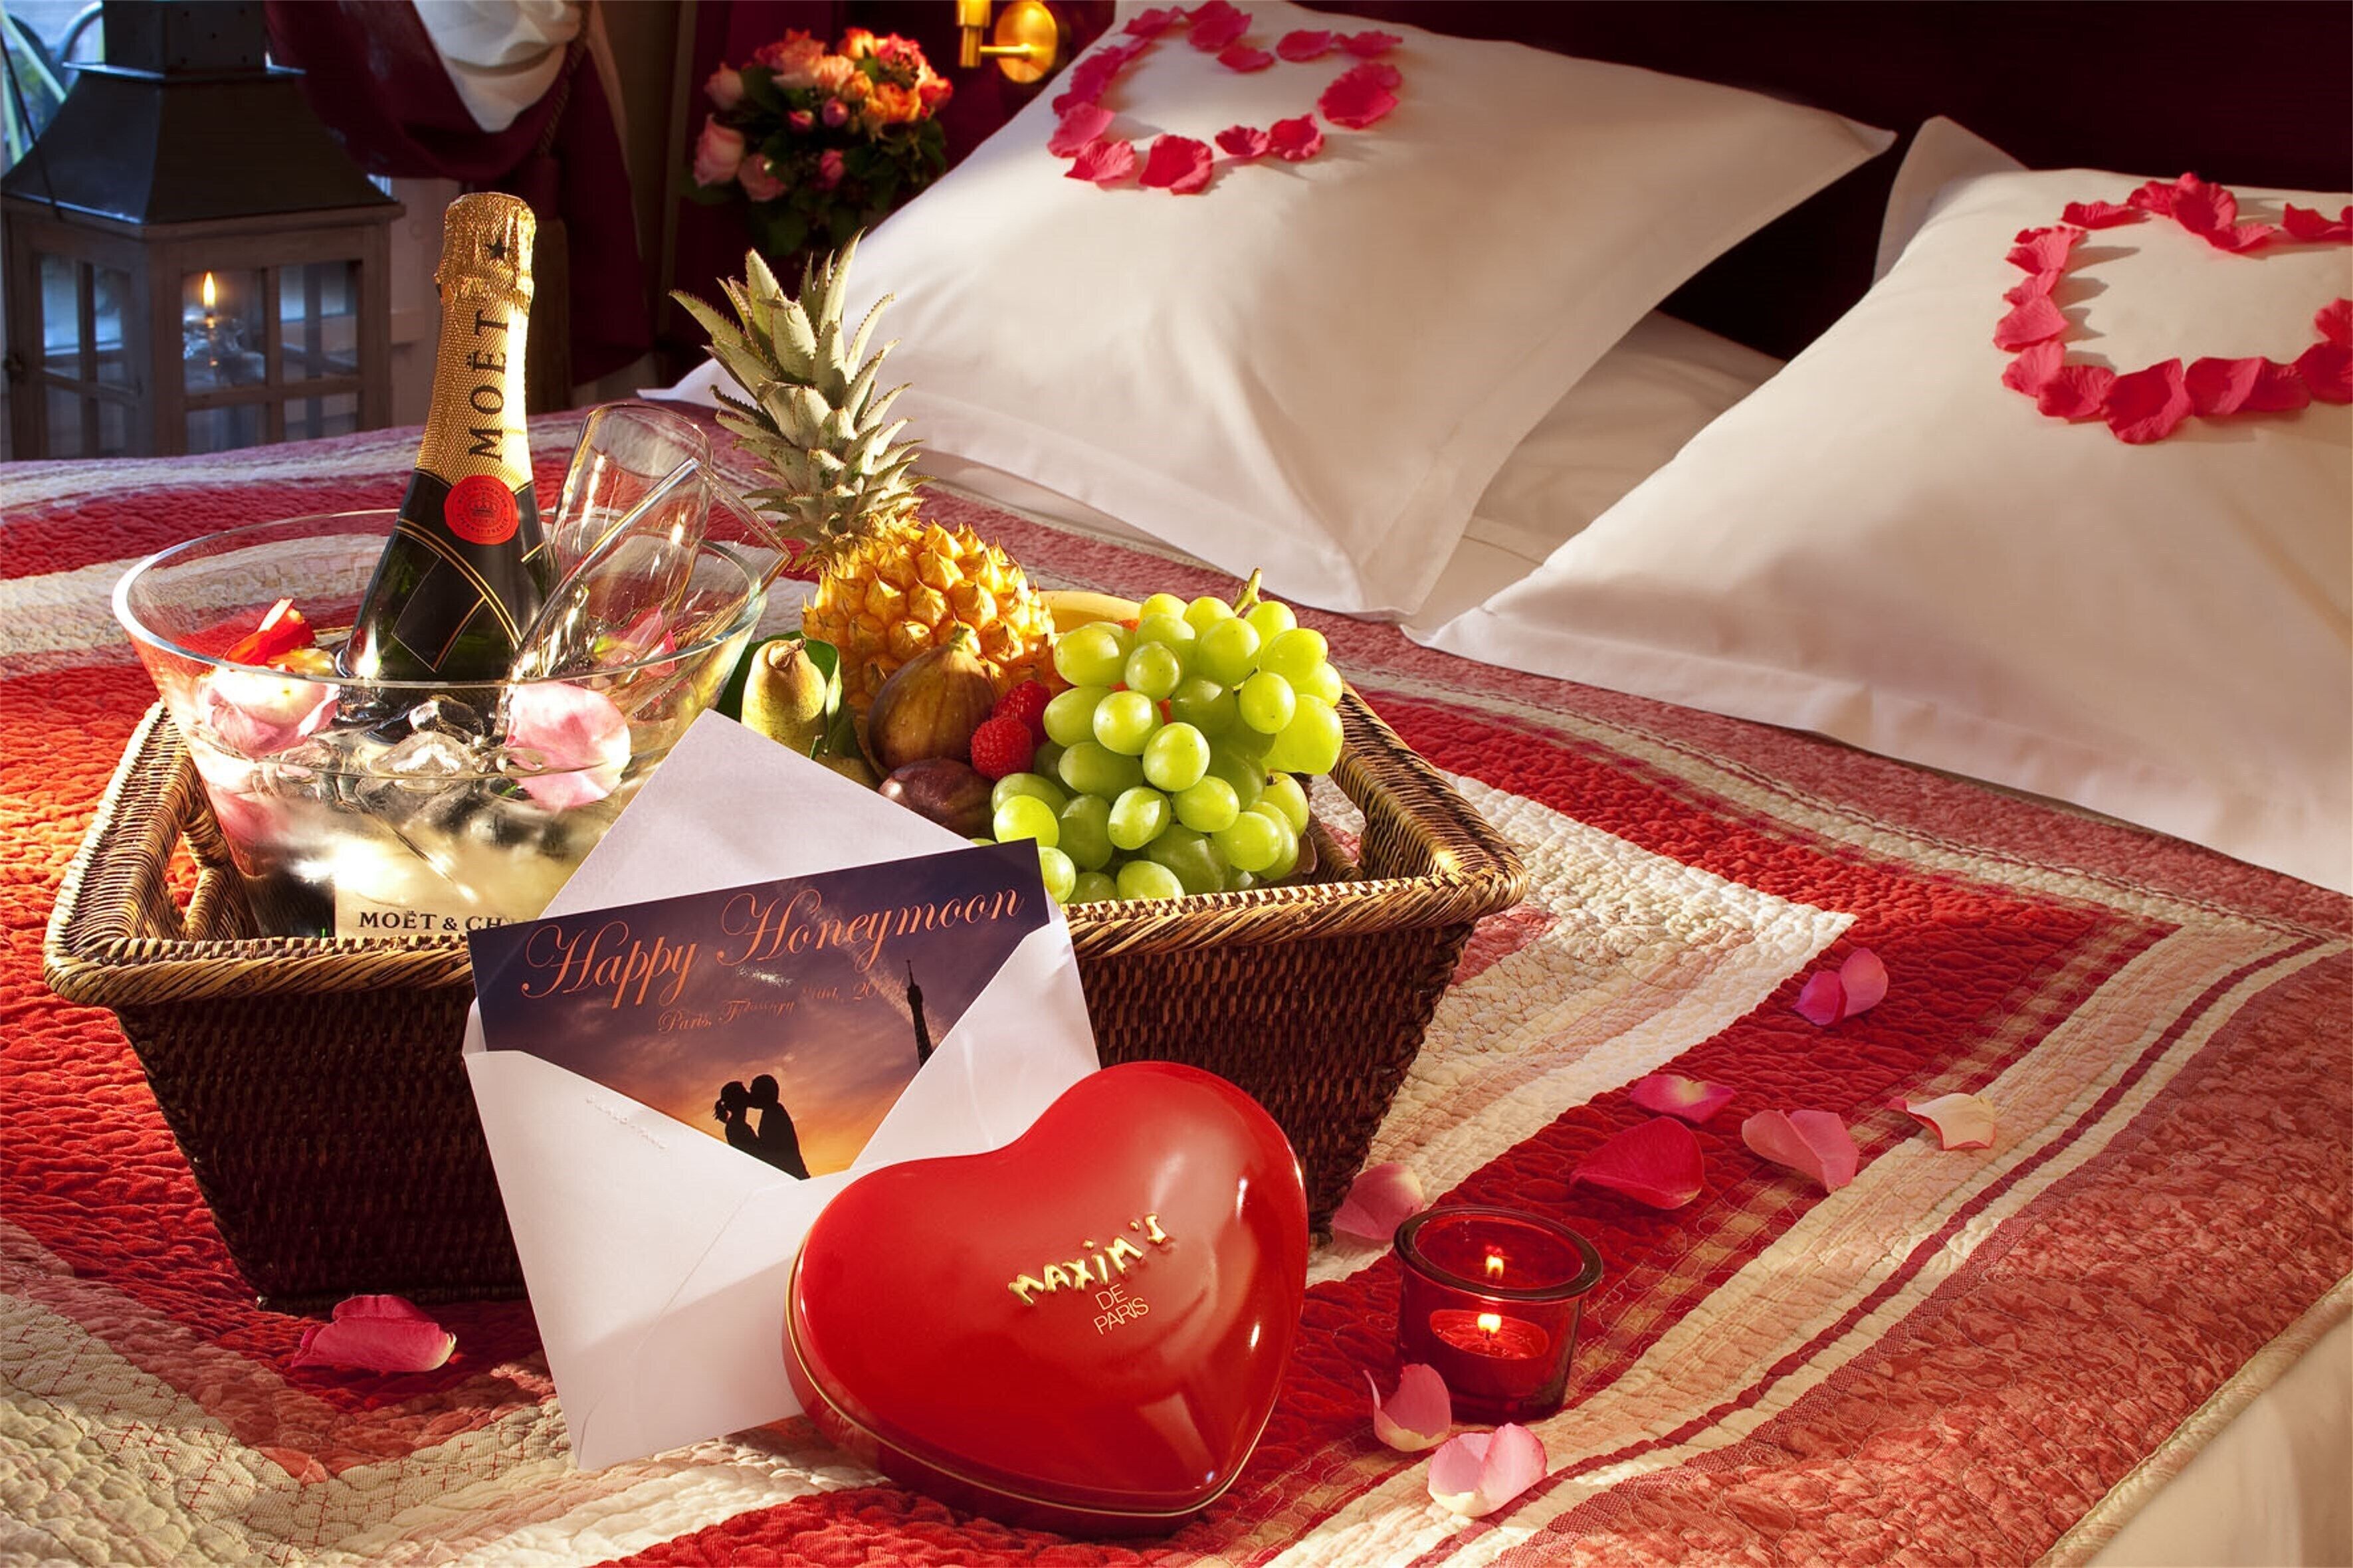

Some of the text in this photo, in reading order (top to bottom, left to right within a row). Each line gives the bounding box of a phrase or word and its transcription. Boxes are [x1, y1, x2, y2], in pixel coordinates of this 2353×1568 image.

[466, 309, 508, 462] MOËT
[359, 910, 437, 930] MOËT
[442, 917, 458, 931] &
[521, 888, 1025, 1010] Happy Honeymoon
[1094, 1297, 1150, 1335] PARIS
[1095, 1283, 1128, 1311] DE
